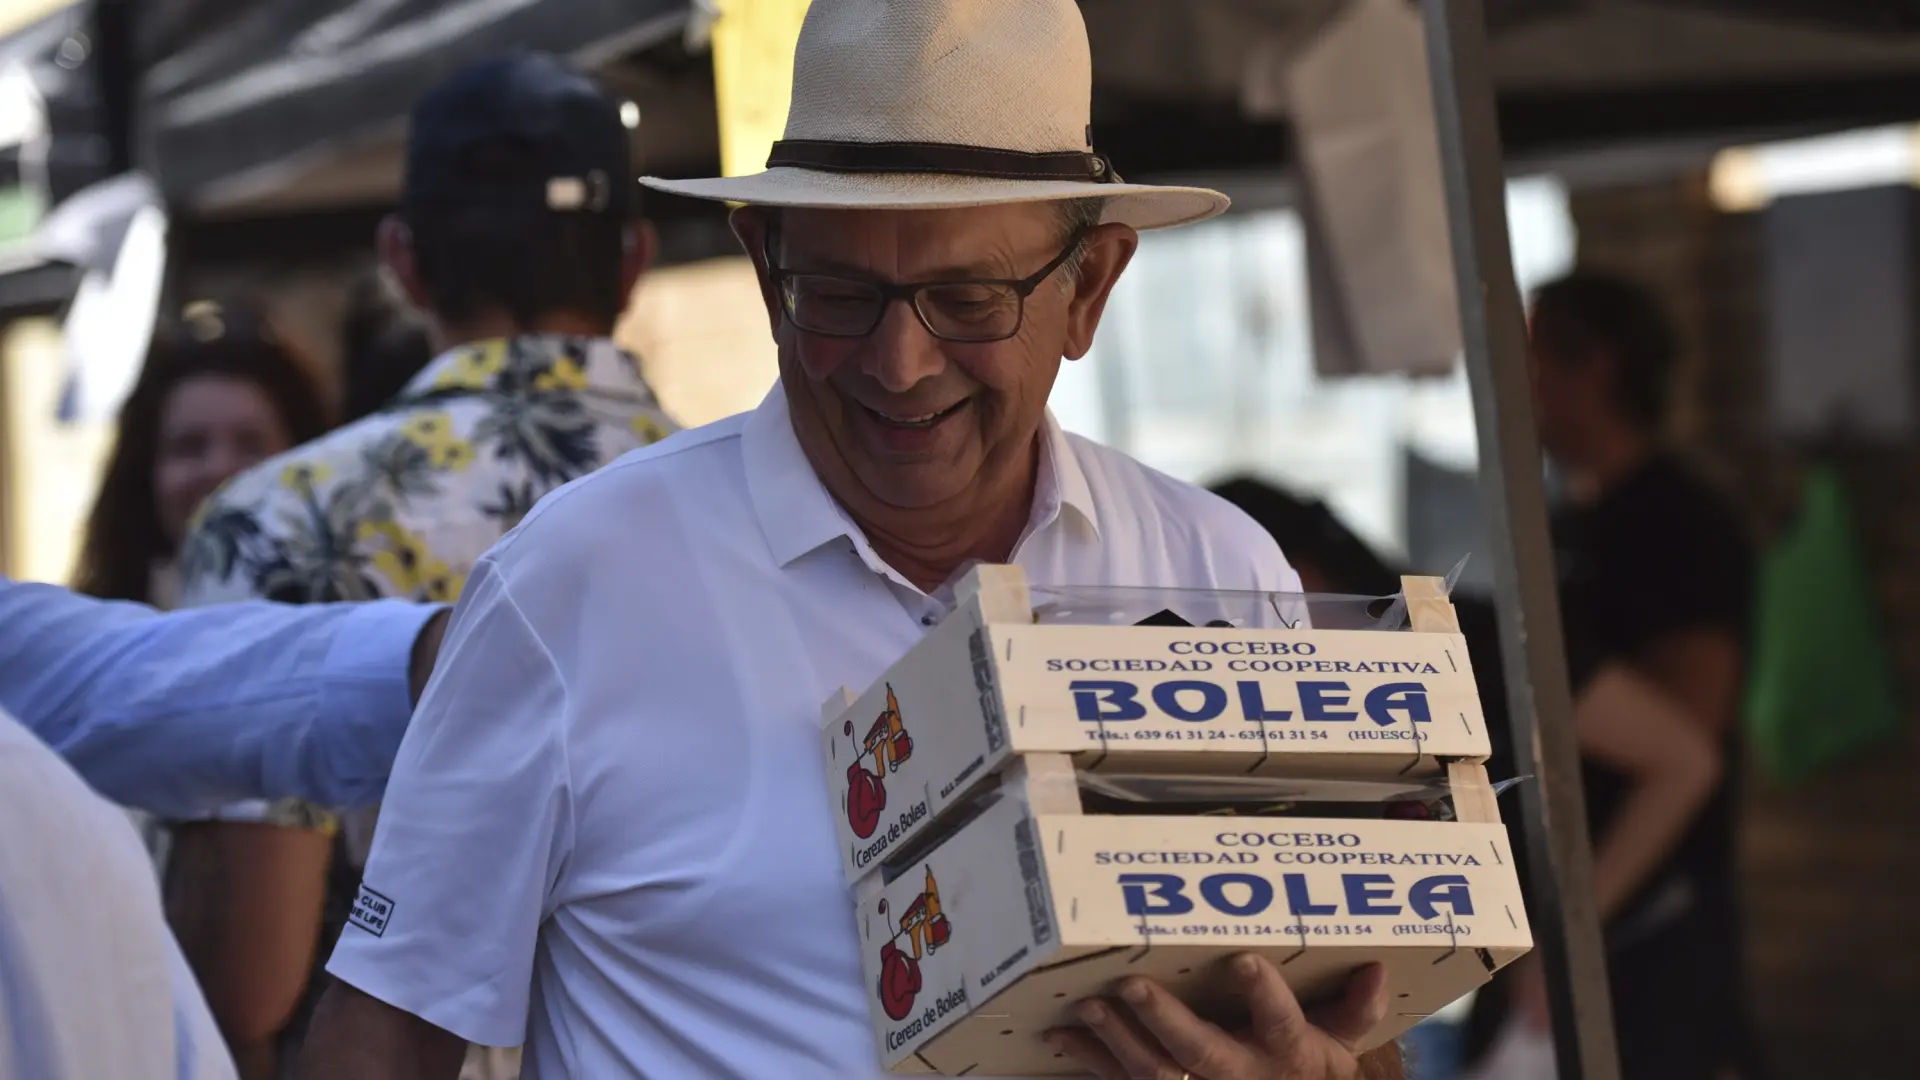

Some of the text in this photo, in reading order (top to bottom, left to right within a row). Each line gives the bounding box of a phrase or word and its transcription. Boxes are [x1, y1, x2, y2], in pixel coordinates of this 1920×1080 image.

[1168, 641, 1317, 656] COCEBO
[1046, 658, 1440, 674] SOCIEDAD COOPERATIVA
[1069, 680, 1432, 727] BOLEA
[1134, 730, 1161, 740] 639
[1165, 730, 1182, 740] 61
[1187, 730, 1204, 740] 31
[1208, 730, 1226, 740] 24
[1238, 730, 1264, 741] 639
[1268, 731, 1285, 740] 61
[1289, 731, 1306, 740] 31
[1311, 731, 1328, 740] 54
[1348, 730, 1429, 742] (HUESCA)
[856, 801, 928, 869] Cereza de Bolea
[1215, 832, 1361, 847] COCEBO
[1094, 851, 1481, 866] SOCIEDAD COOPERATIVA
[1117, 873, 1475, 921] BOLEA
[361, 896, 387, 915] CLUB
[363, 912, 384, 929] LIFE
[1182, 925, 1209, 935] 639
[1212, 925, 1229, 935] 61
[1233, 925, 1250, 935] 31
[1254, 925, 1272, 935] 24
[1313, 925, 1330, 935] 61
[1334, 925, 1350, 935] 31
[1355, 925, 1372, 935] 54
[1392, 924, 1471, 936] (HUESCA)
[889, 987, 967, 1051] Cereza de Bolea
